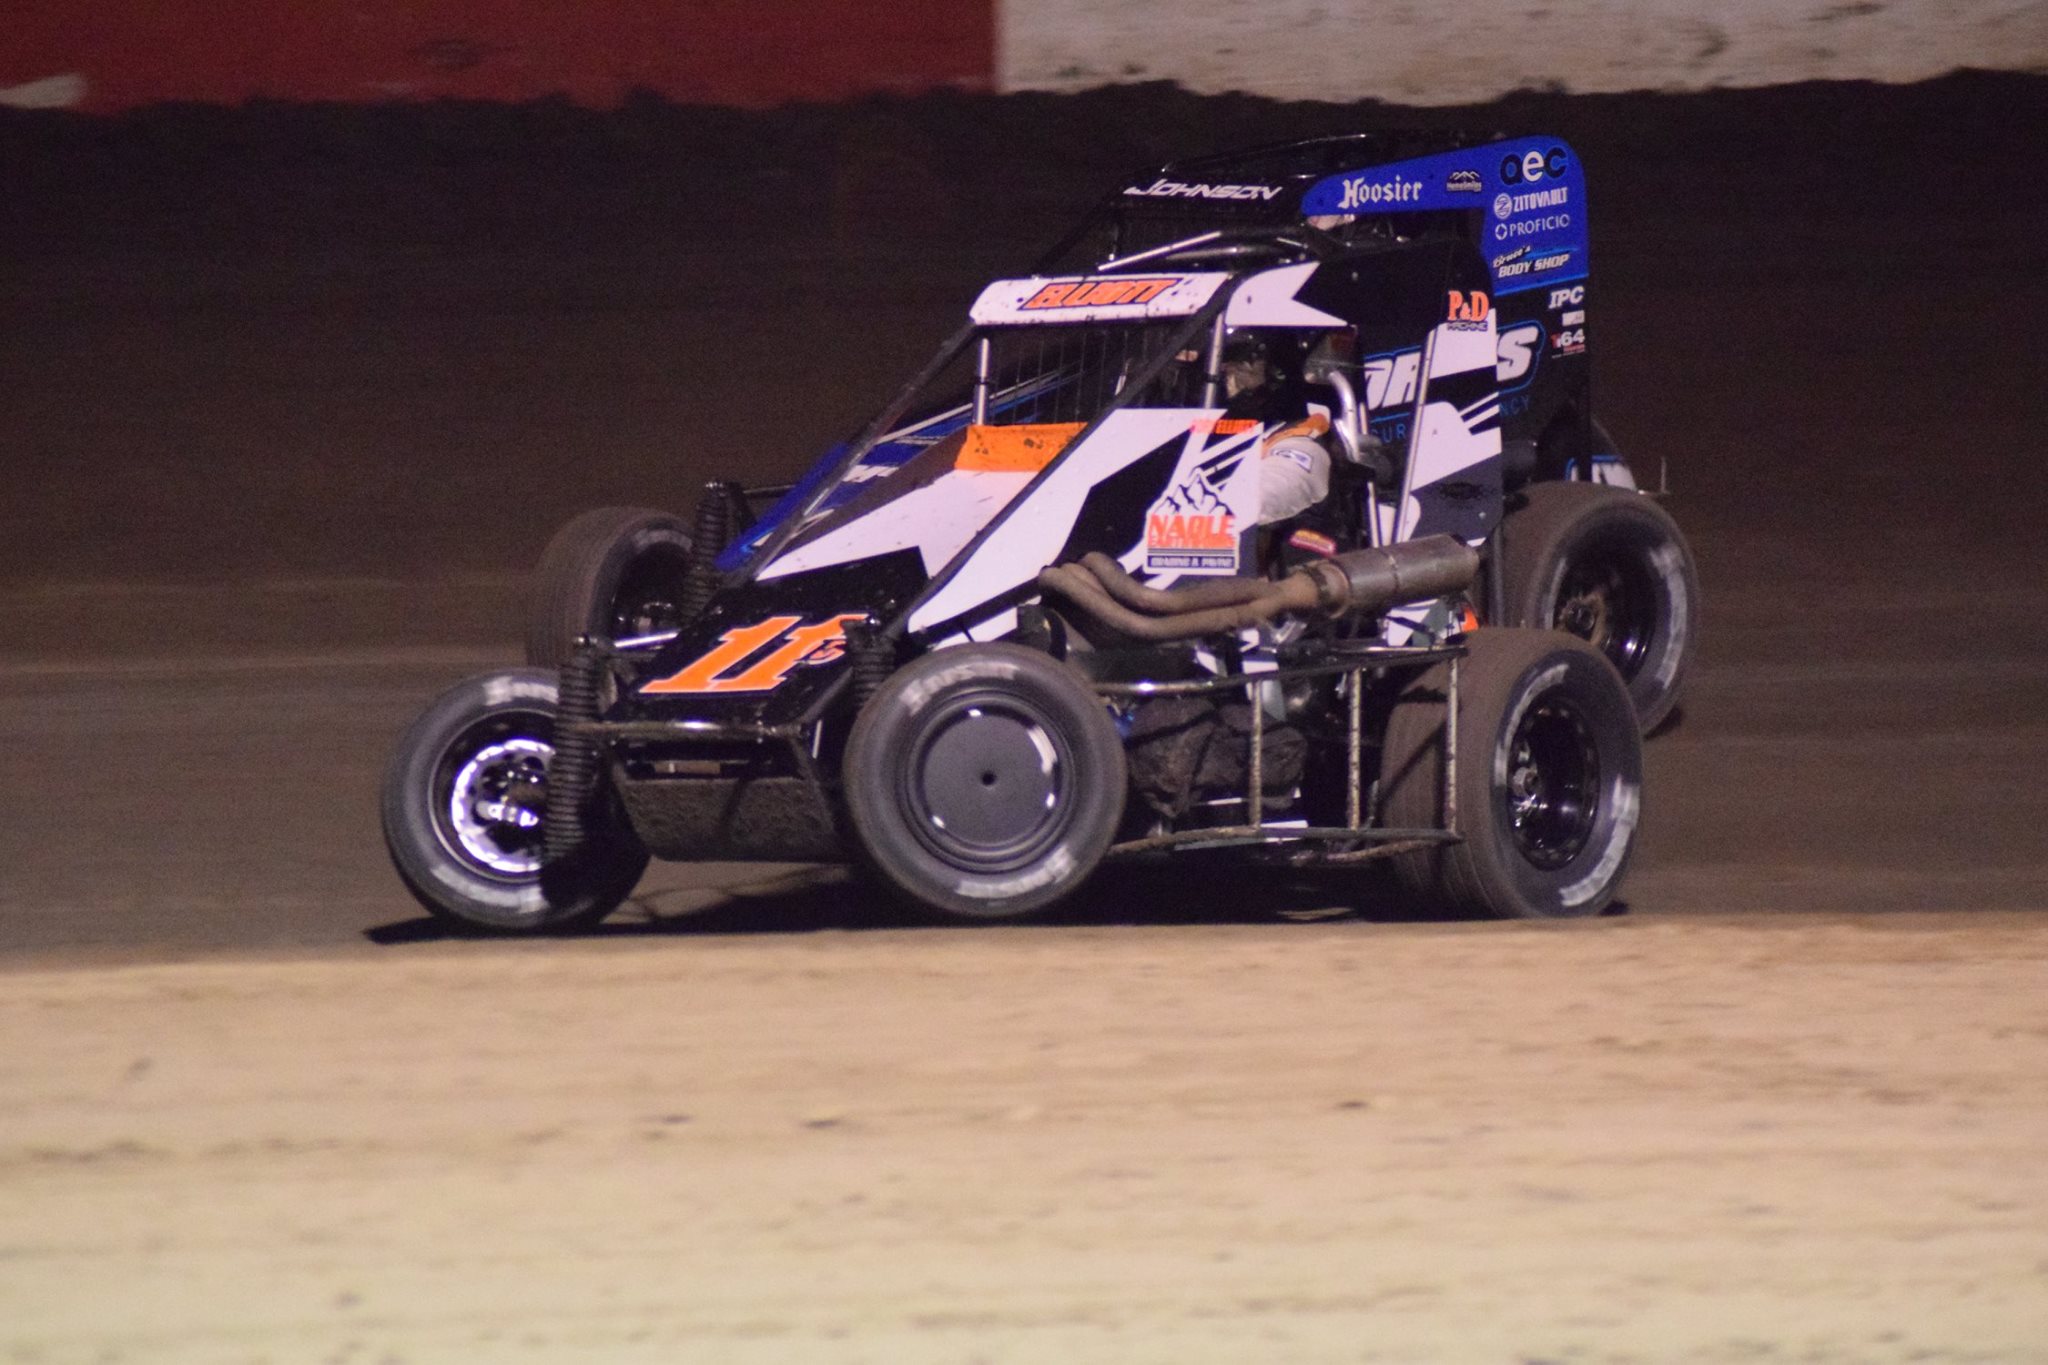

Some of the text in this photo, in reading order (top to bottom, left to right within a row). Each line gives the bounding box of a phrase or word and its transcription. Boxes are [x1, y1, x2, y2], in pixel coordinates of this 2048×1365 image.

[1501, 147, 1568, 186] aec
[1123, 178, 1283, 201] JOHNSON
[1337, 174, 1423, 210] Hoosier
[1513, 187, 1568, 213] ZITOVAULT
[1509, 214, 1571, 237] PROFICIO
[1498, 253, 1570, 278] BODY SHOP
[1447, 290, 1490, 322] P&D
[1548, 286, 1585, 309] IPC
